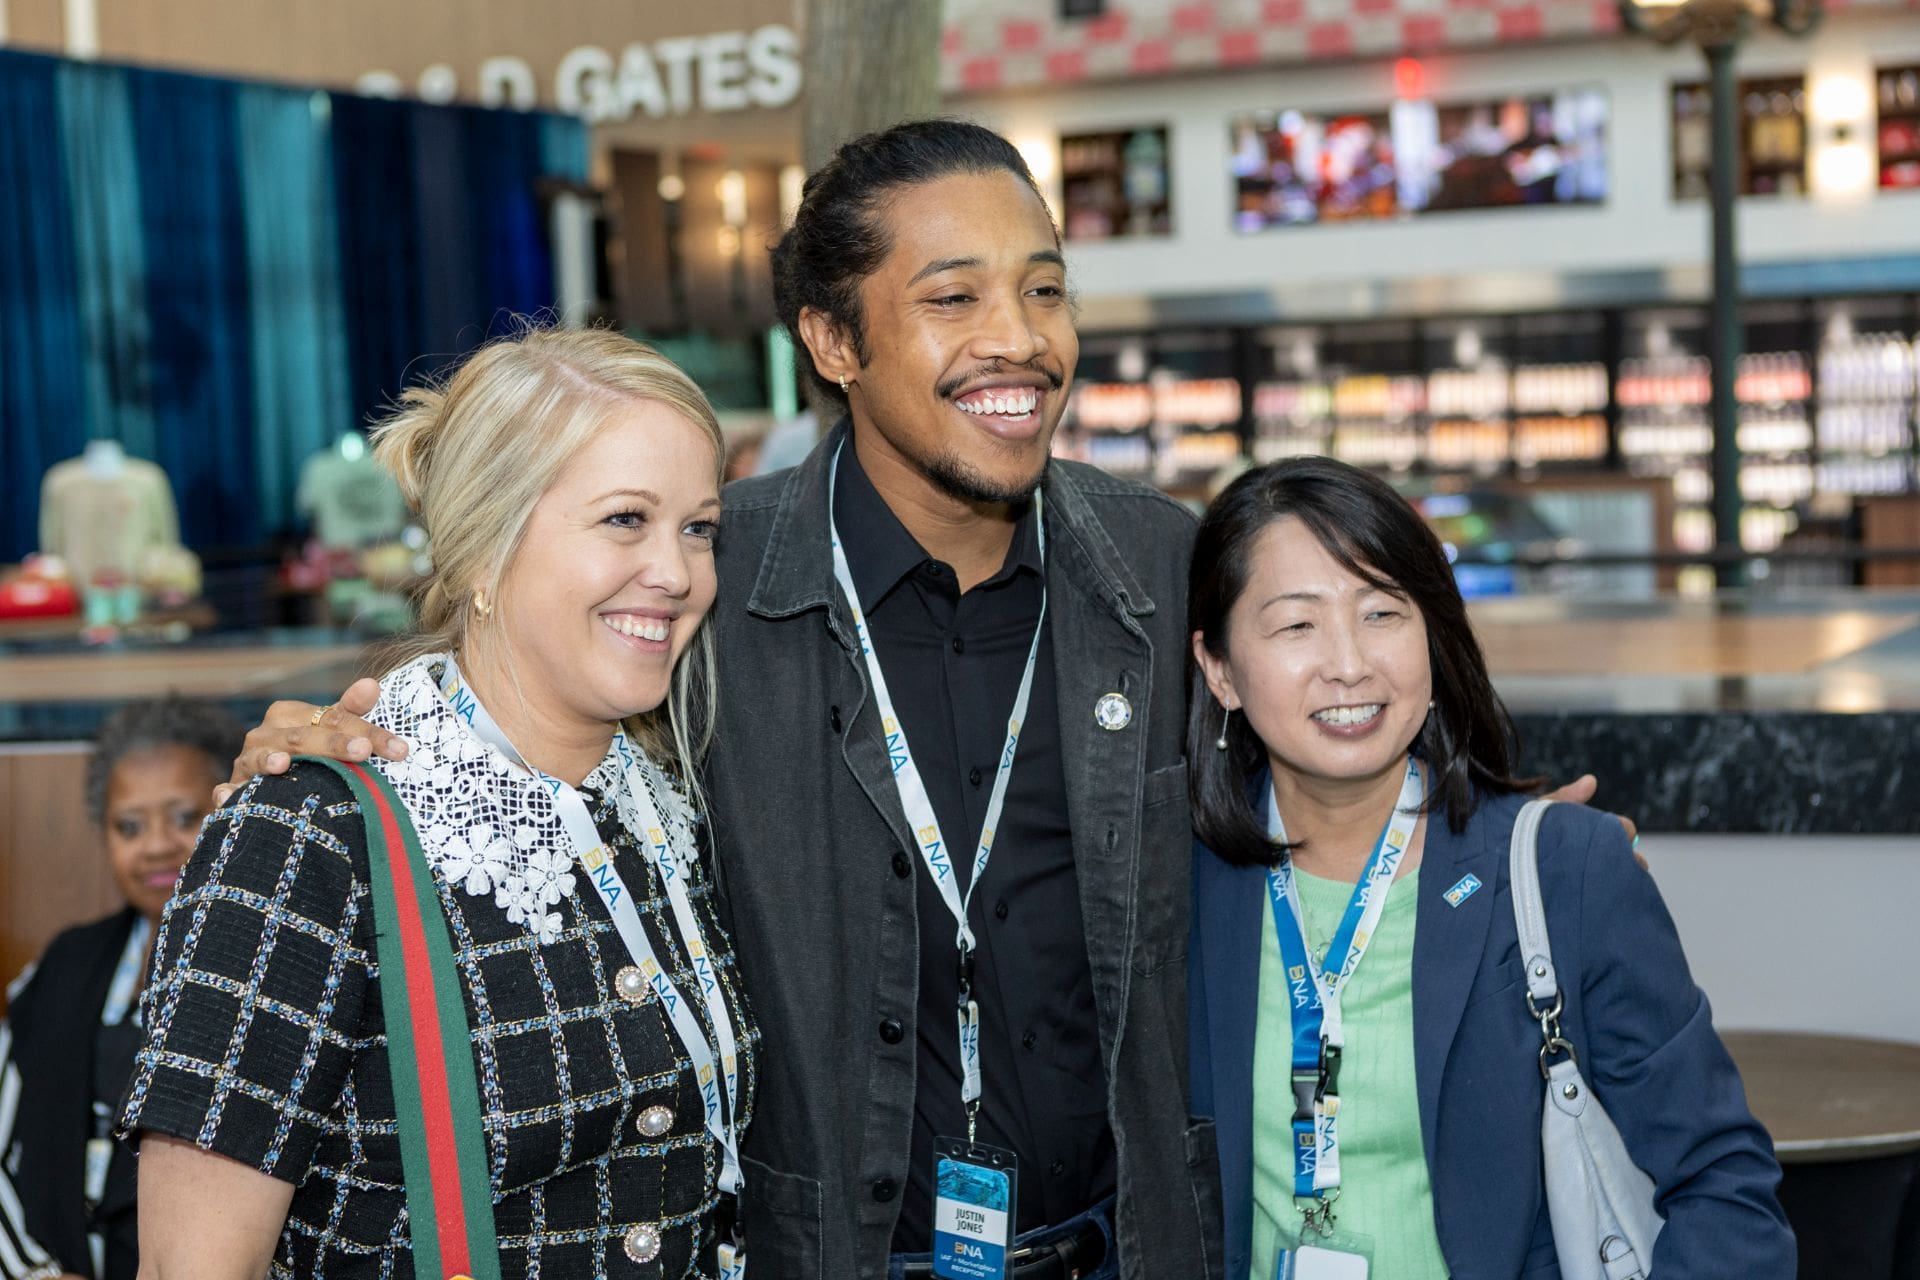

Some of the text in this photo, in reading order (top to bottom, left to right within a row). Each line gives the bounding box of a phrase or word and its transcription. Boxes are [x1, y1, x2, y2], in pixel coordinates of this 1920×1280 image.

[554, 23, 803, 124] GATES
[445, 676, 477, 726] BNA
[882, 716, 908, 774] BNA
[1000, 719, 1020, 770] BNA
[583, 847, 622, 906] BNA
[648, 827, 676, 881] BNA
[918, 824, 951, 880] BNA
[1378, 827, 1406, 876] BNA
[1446, 878, 1479, 903] BNA
[688, 940, 716, 993] BNA
[1341, 930, 1368, 978] BNA
[642, 958, 676, 1013] BNA
[1288, 965, 1309, 1009] BNA
[699, 1063, 718, 1121] BNA
[1322, 1100, 1338, 1153] BNA
[1298, 1133, 1316, 1175] BNA
[955, 1208, 985, 1223] JUSTIN
[957, 1220, 983, 1234] JONES
[954, 1241, 984, 1260] BNA
